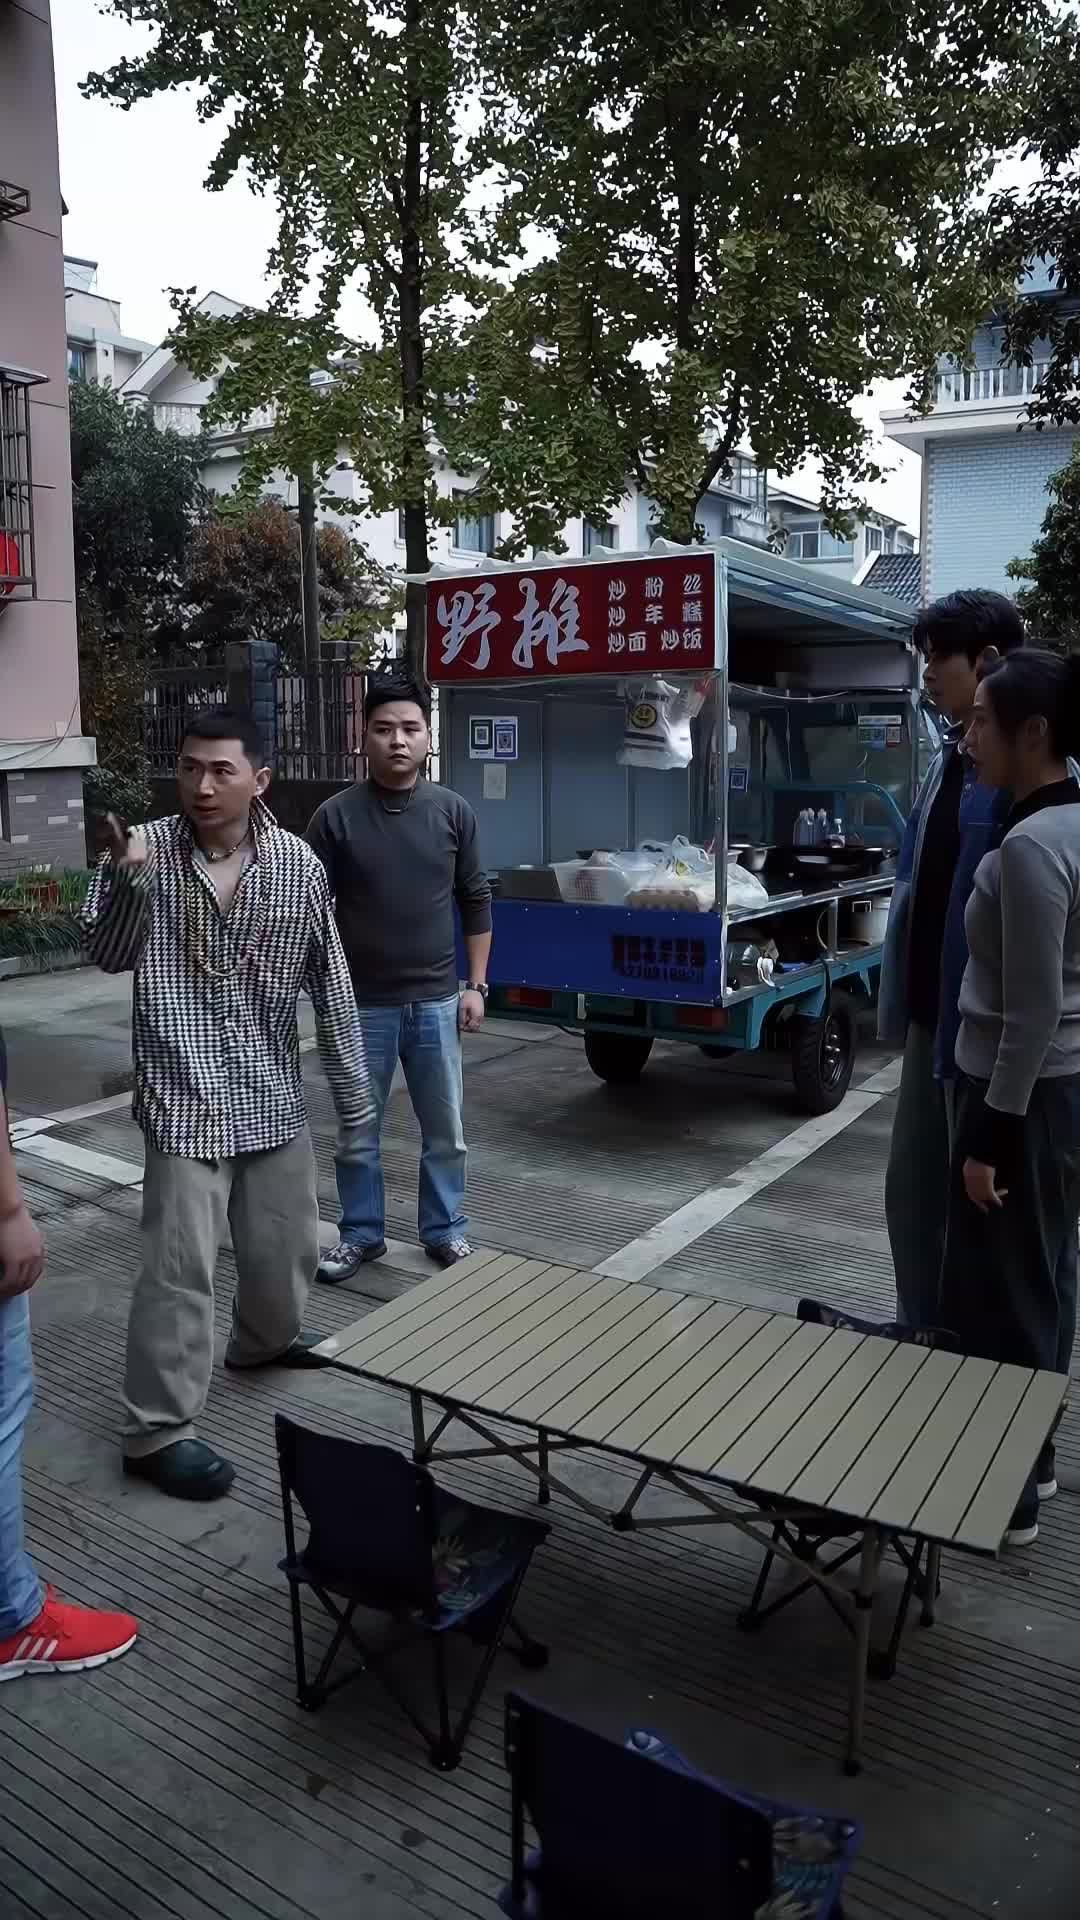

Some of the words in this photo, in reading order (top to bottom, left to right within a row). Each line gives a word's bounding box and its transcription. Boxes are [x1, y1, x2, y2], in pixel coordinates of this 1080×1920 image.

[608, 574, 702, 601] 炒粉丝
[437, 577, 590, 670] 野摊
[608, 600, 702, 627] 炒年糕
[608, 631, 647, 653] 炒面
[661, 628, 702, 651] 炒饭
